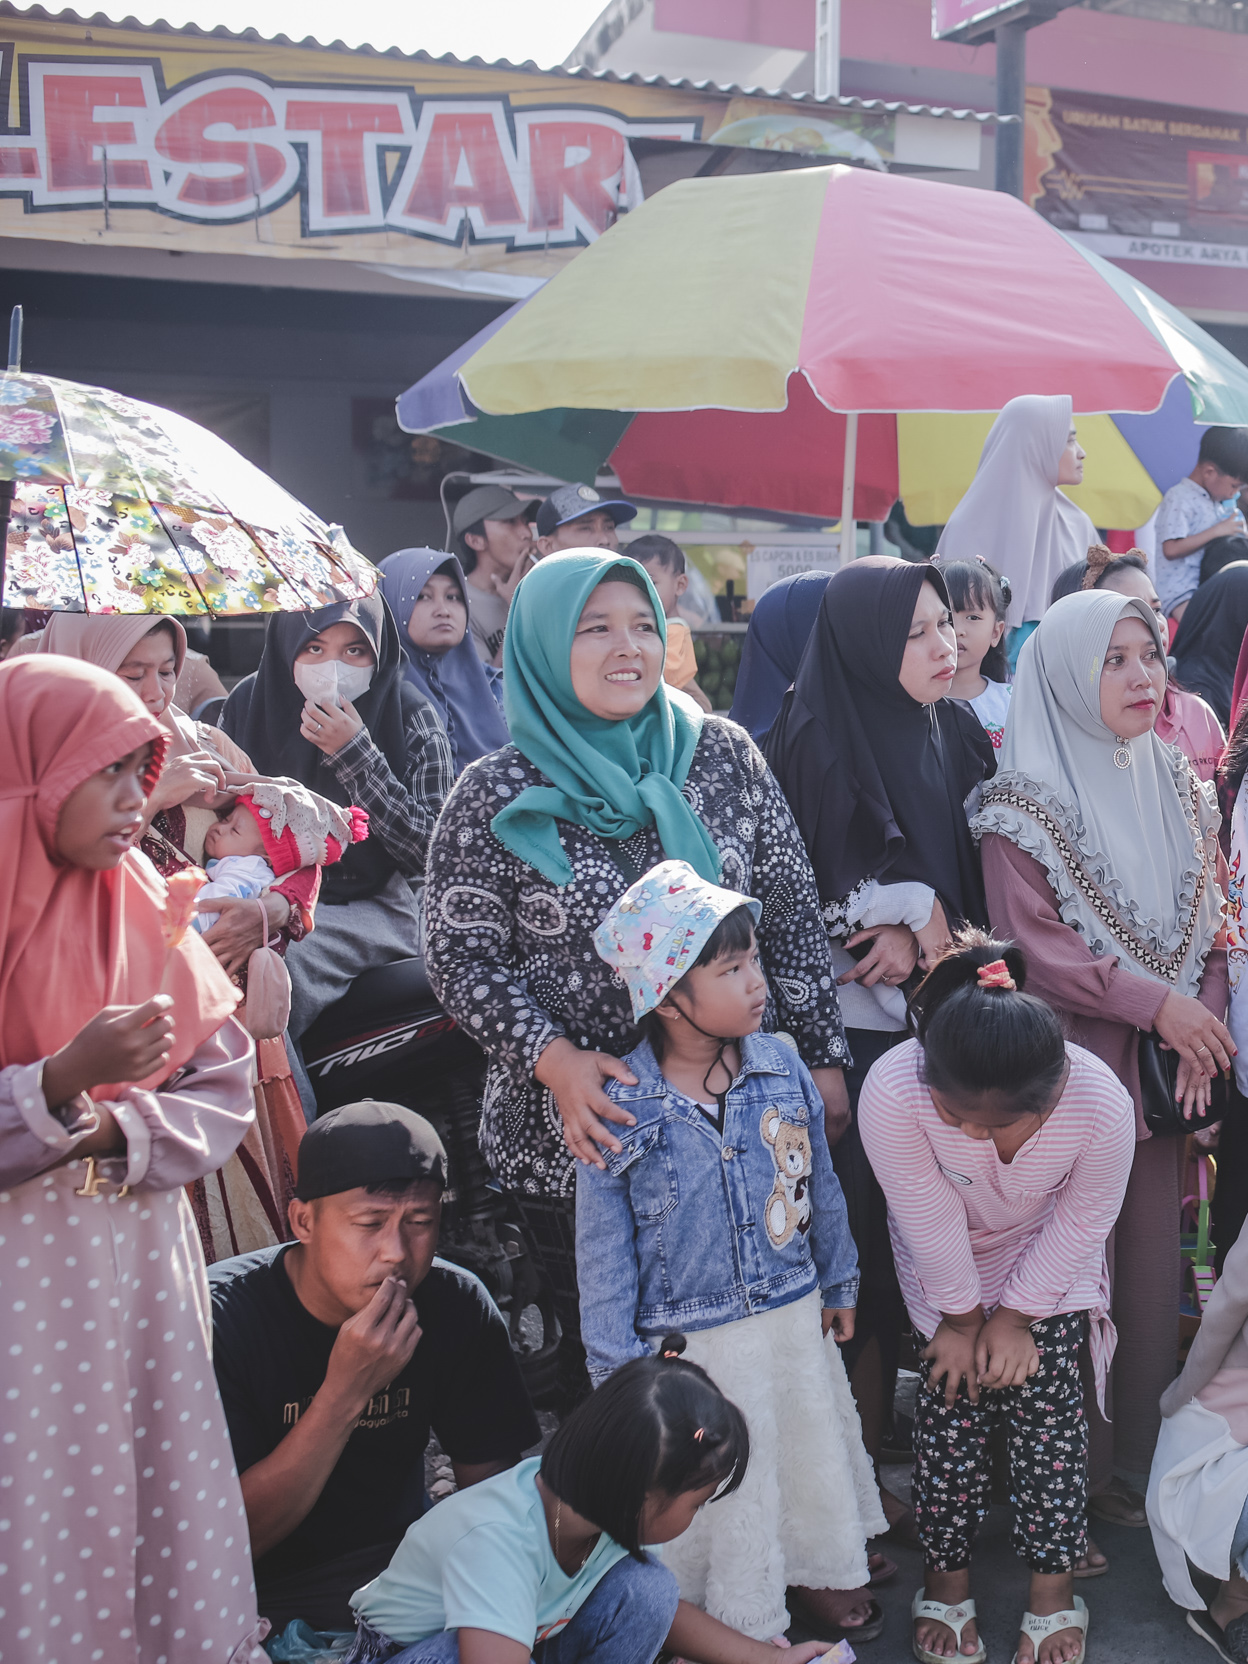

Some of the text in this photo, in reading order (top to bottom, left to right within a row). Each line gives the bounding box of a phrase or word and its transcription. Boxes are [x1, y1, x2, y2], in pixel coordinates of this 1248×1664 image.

[1128, 241, 1195, 259] APOTEK
[1200, 247, 1241, 262] ARYA
[666, 927, 685, 965] HELLO
[675, 929, 696, 969] KITTY
